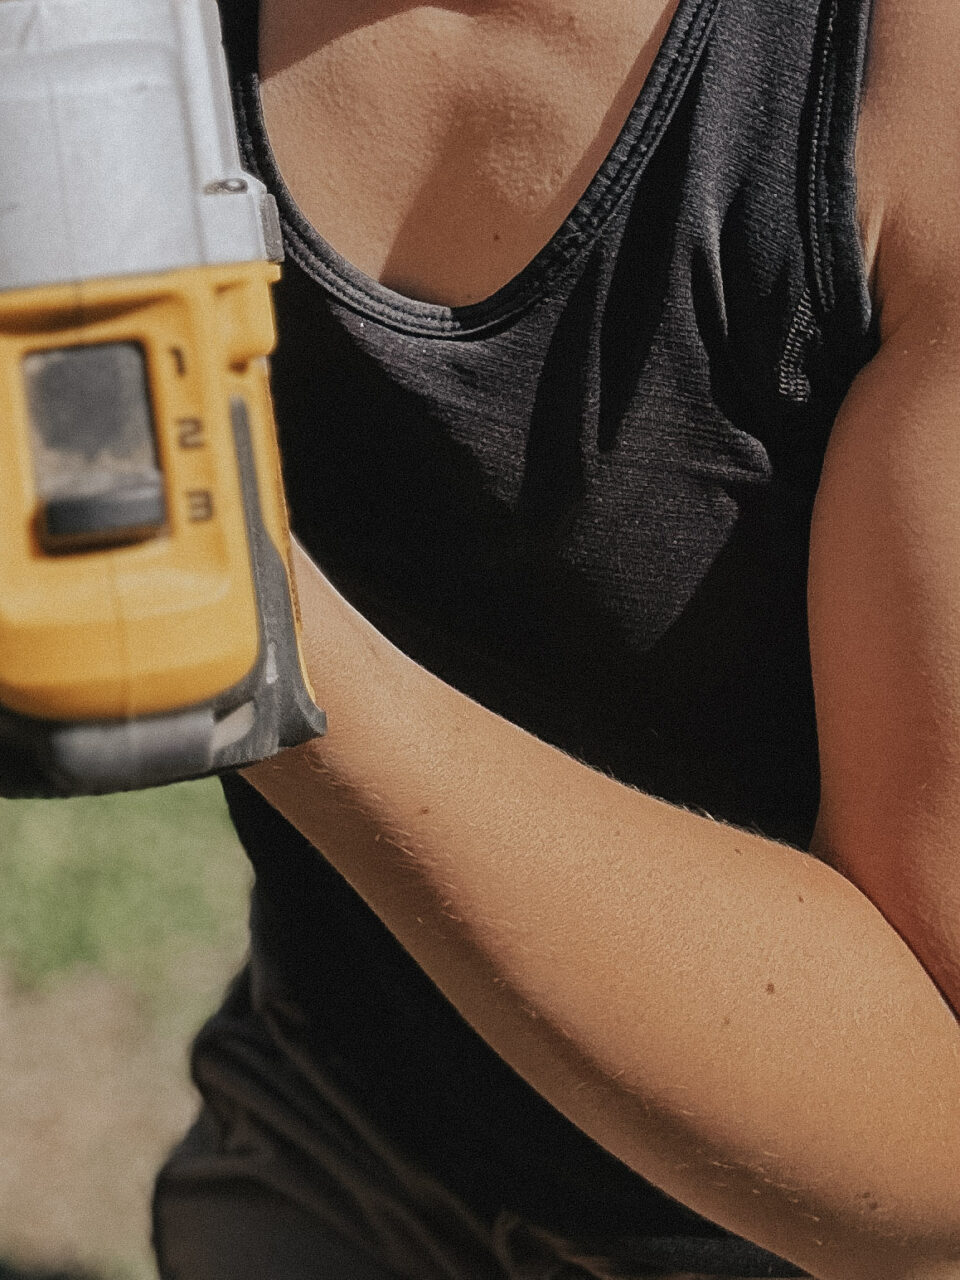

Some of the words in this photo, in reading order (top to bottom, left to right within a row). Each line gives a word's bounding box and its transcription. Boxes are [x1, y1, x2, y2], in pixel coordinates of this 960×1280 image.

[170, 345, 187, 377] 1
[176, 418, 206, 451] 2
[187, 490, 215, 523] 3
